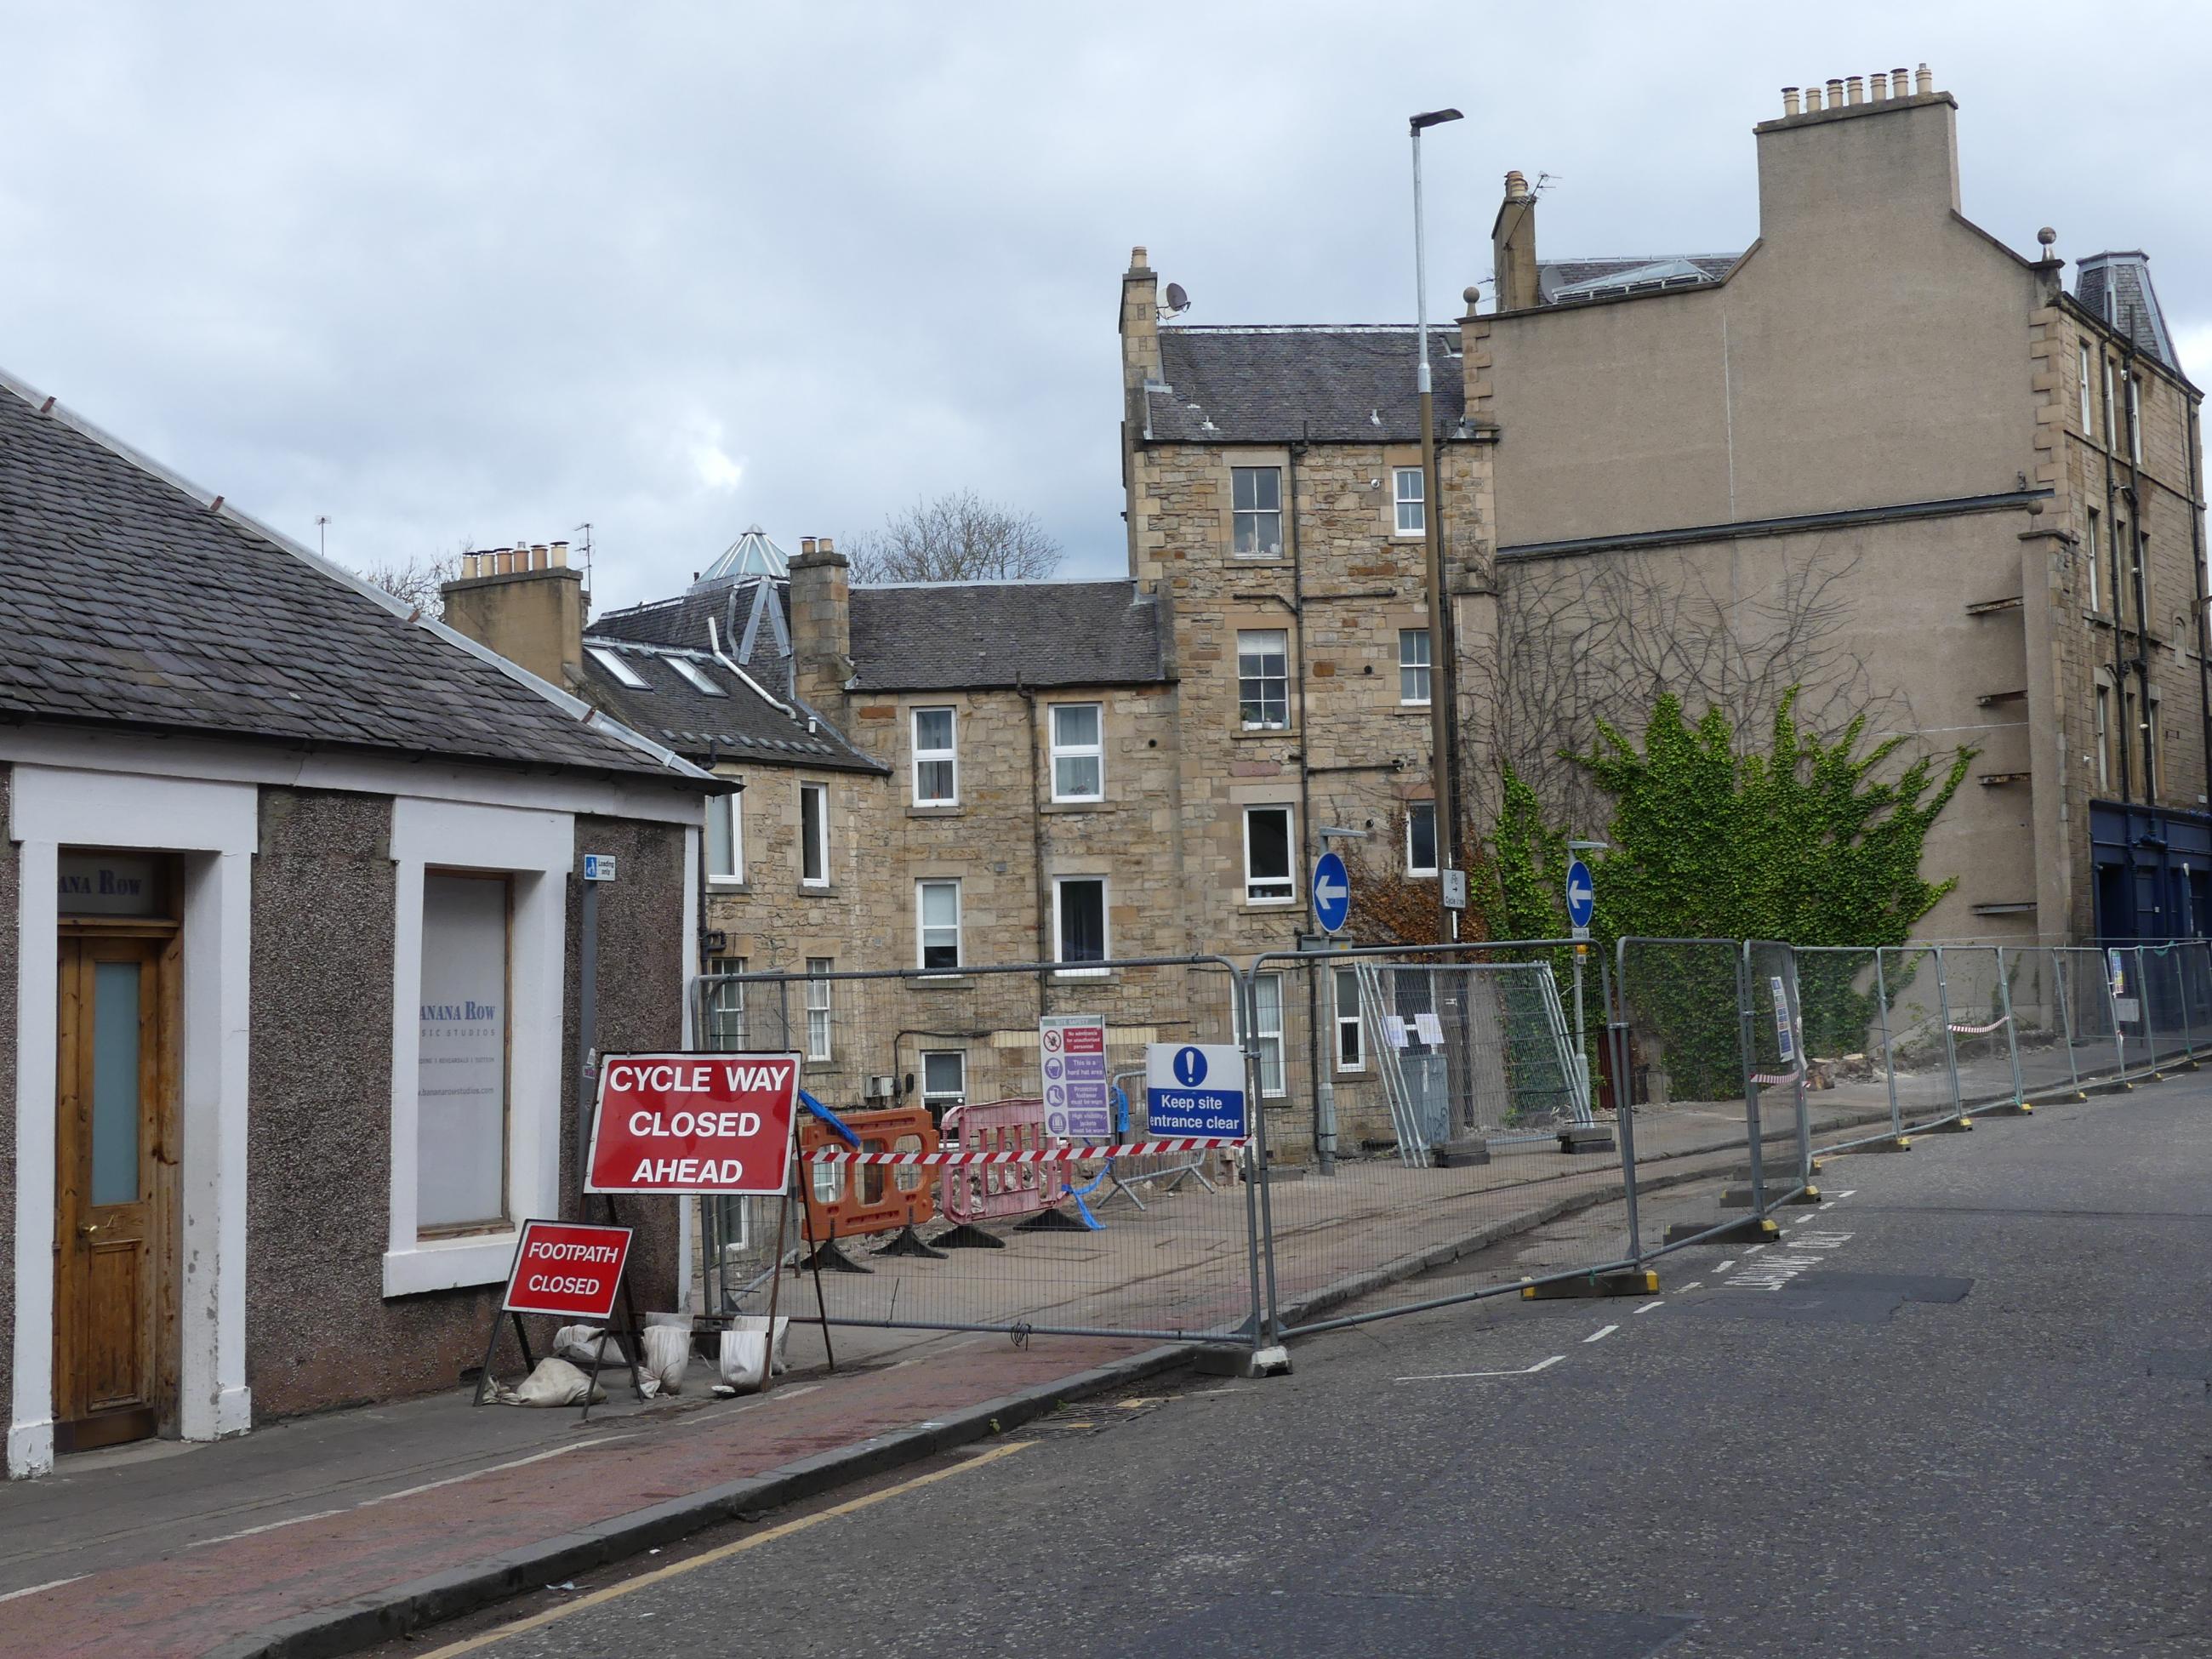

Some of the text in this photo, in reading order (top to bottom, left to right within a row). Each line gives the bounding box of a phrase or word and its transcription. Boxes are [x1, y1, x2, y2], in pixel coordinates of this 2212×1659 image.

[58, 876, 92, 894] ANA
[419, 1005, 461, 1021] ANANA
[421, 1029, 441, 1037] SIC
[609, 1066, 790, 1092] CYCLE WAY
[1161, 1094, 1223, 1112] Keep site
[628, 1111, 761, 1137] CLOSED
[1149, 1115, 1240, 1130] entrance clear
[631, 1159, 743, 1183] AHEAD
[528, 1241, 619, 1263] FOOTPATH
[528, 1274, 600, 1296] CLOSED
